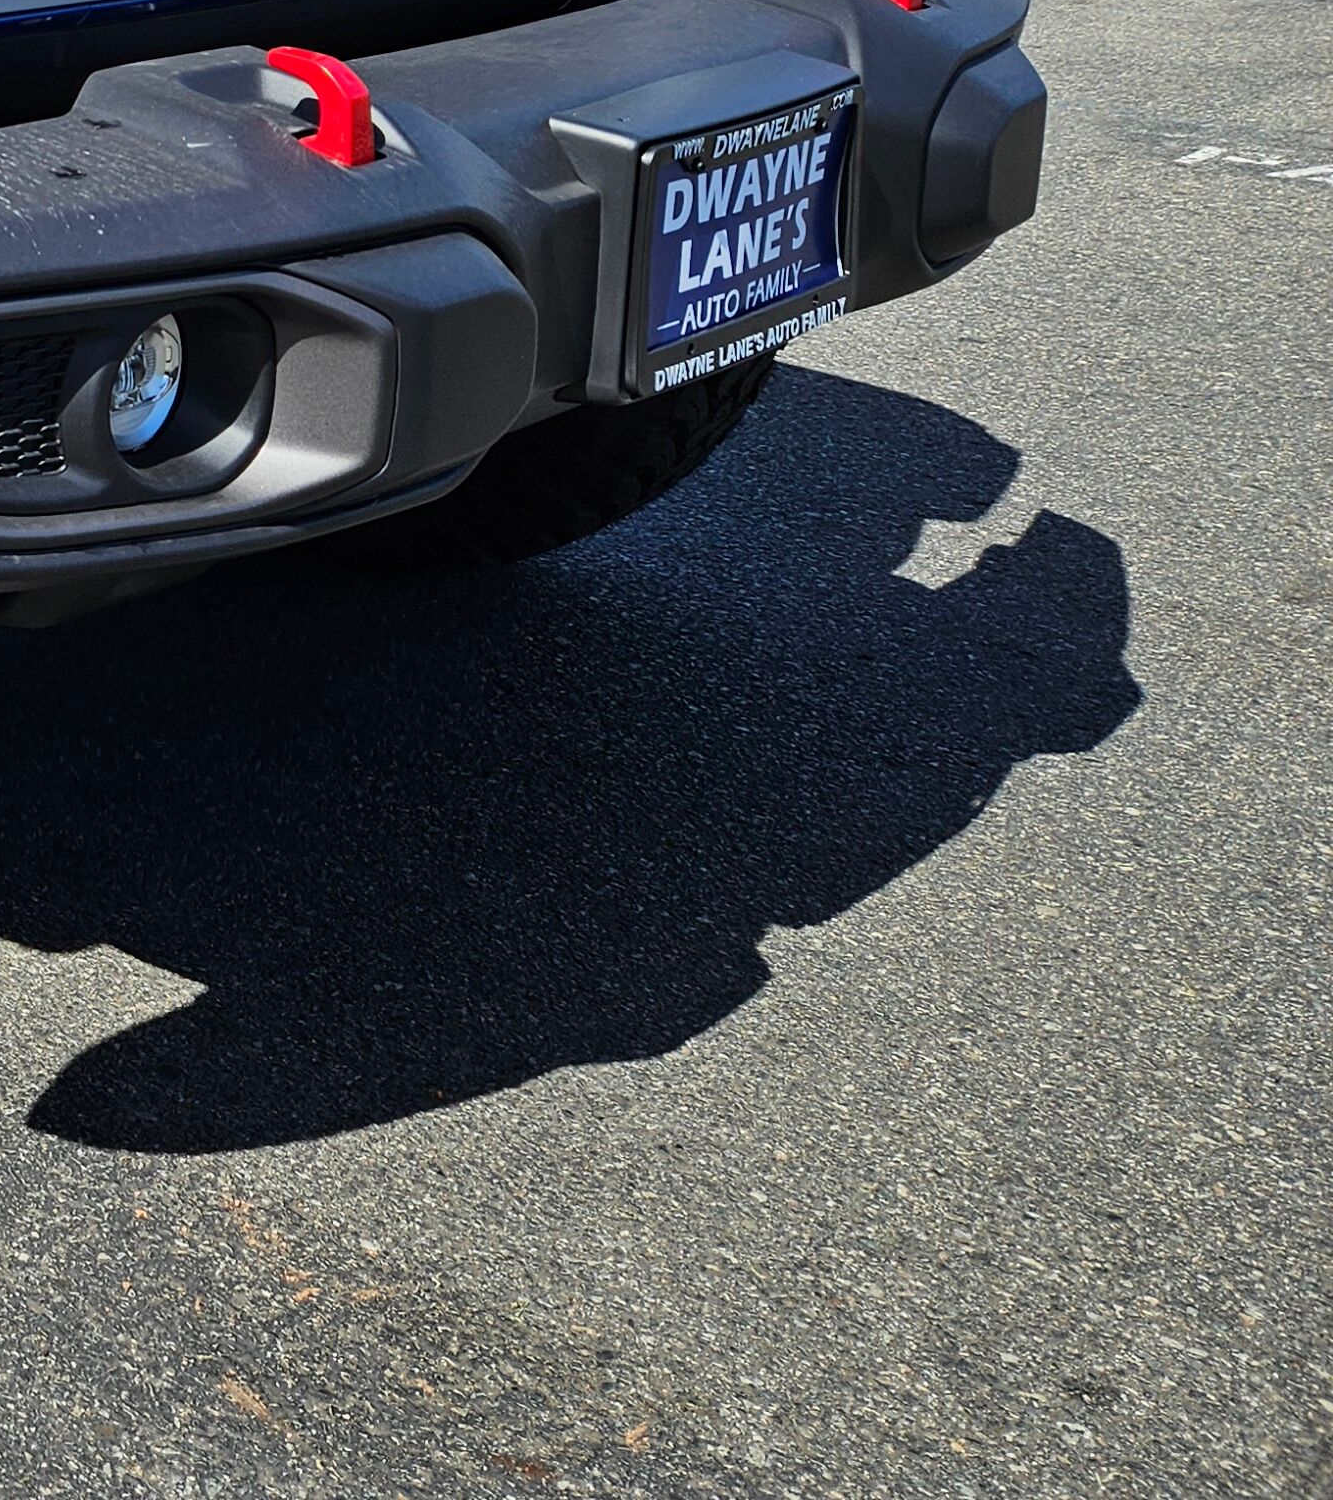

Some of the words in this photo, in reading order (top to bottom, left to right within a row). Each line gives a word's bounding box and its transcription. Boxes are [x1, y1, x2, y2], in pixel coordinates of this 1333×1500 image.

[713, 104, 821, 159] DWAYNELANE
[663, 131, 831, 234] DWAYNE
[678, 197, 809, 294] LANE'S
[654, 350, 715, 392] DWAYNE
[719, 333, 765, 367] LANE'S
[766, 318, 800, 348] AUTO
[801, 296, 847, 332] FAMILY
[680, 288, 740, 336] AUTO
[745, 259, 803, 310] FAMILY
